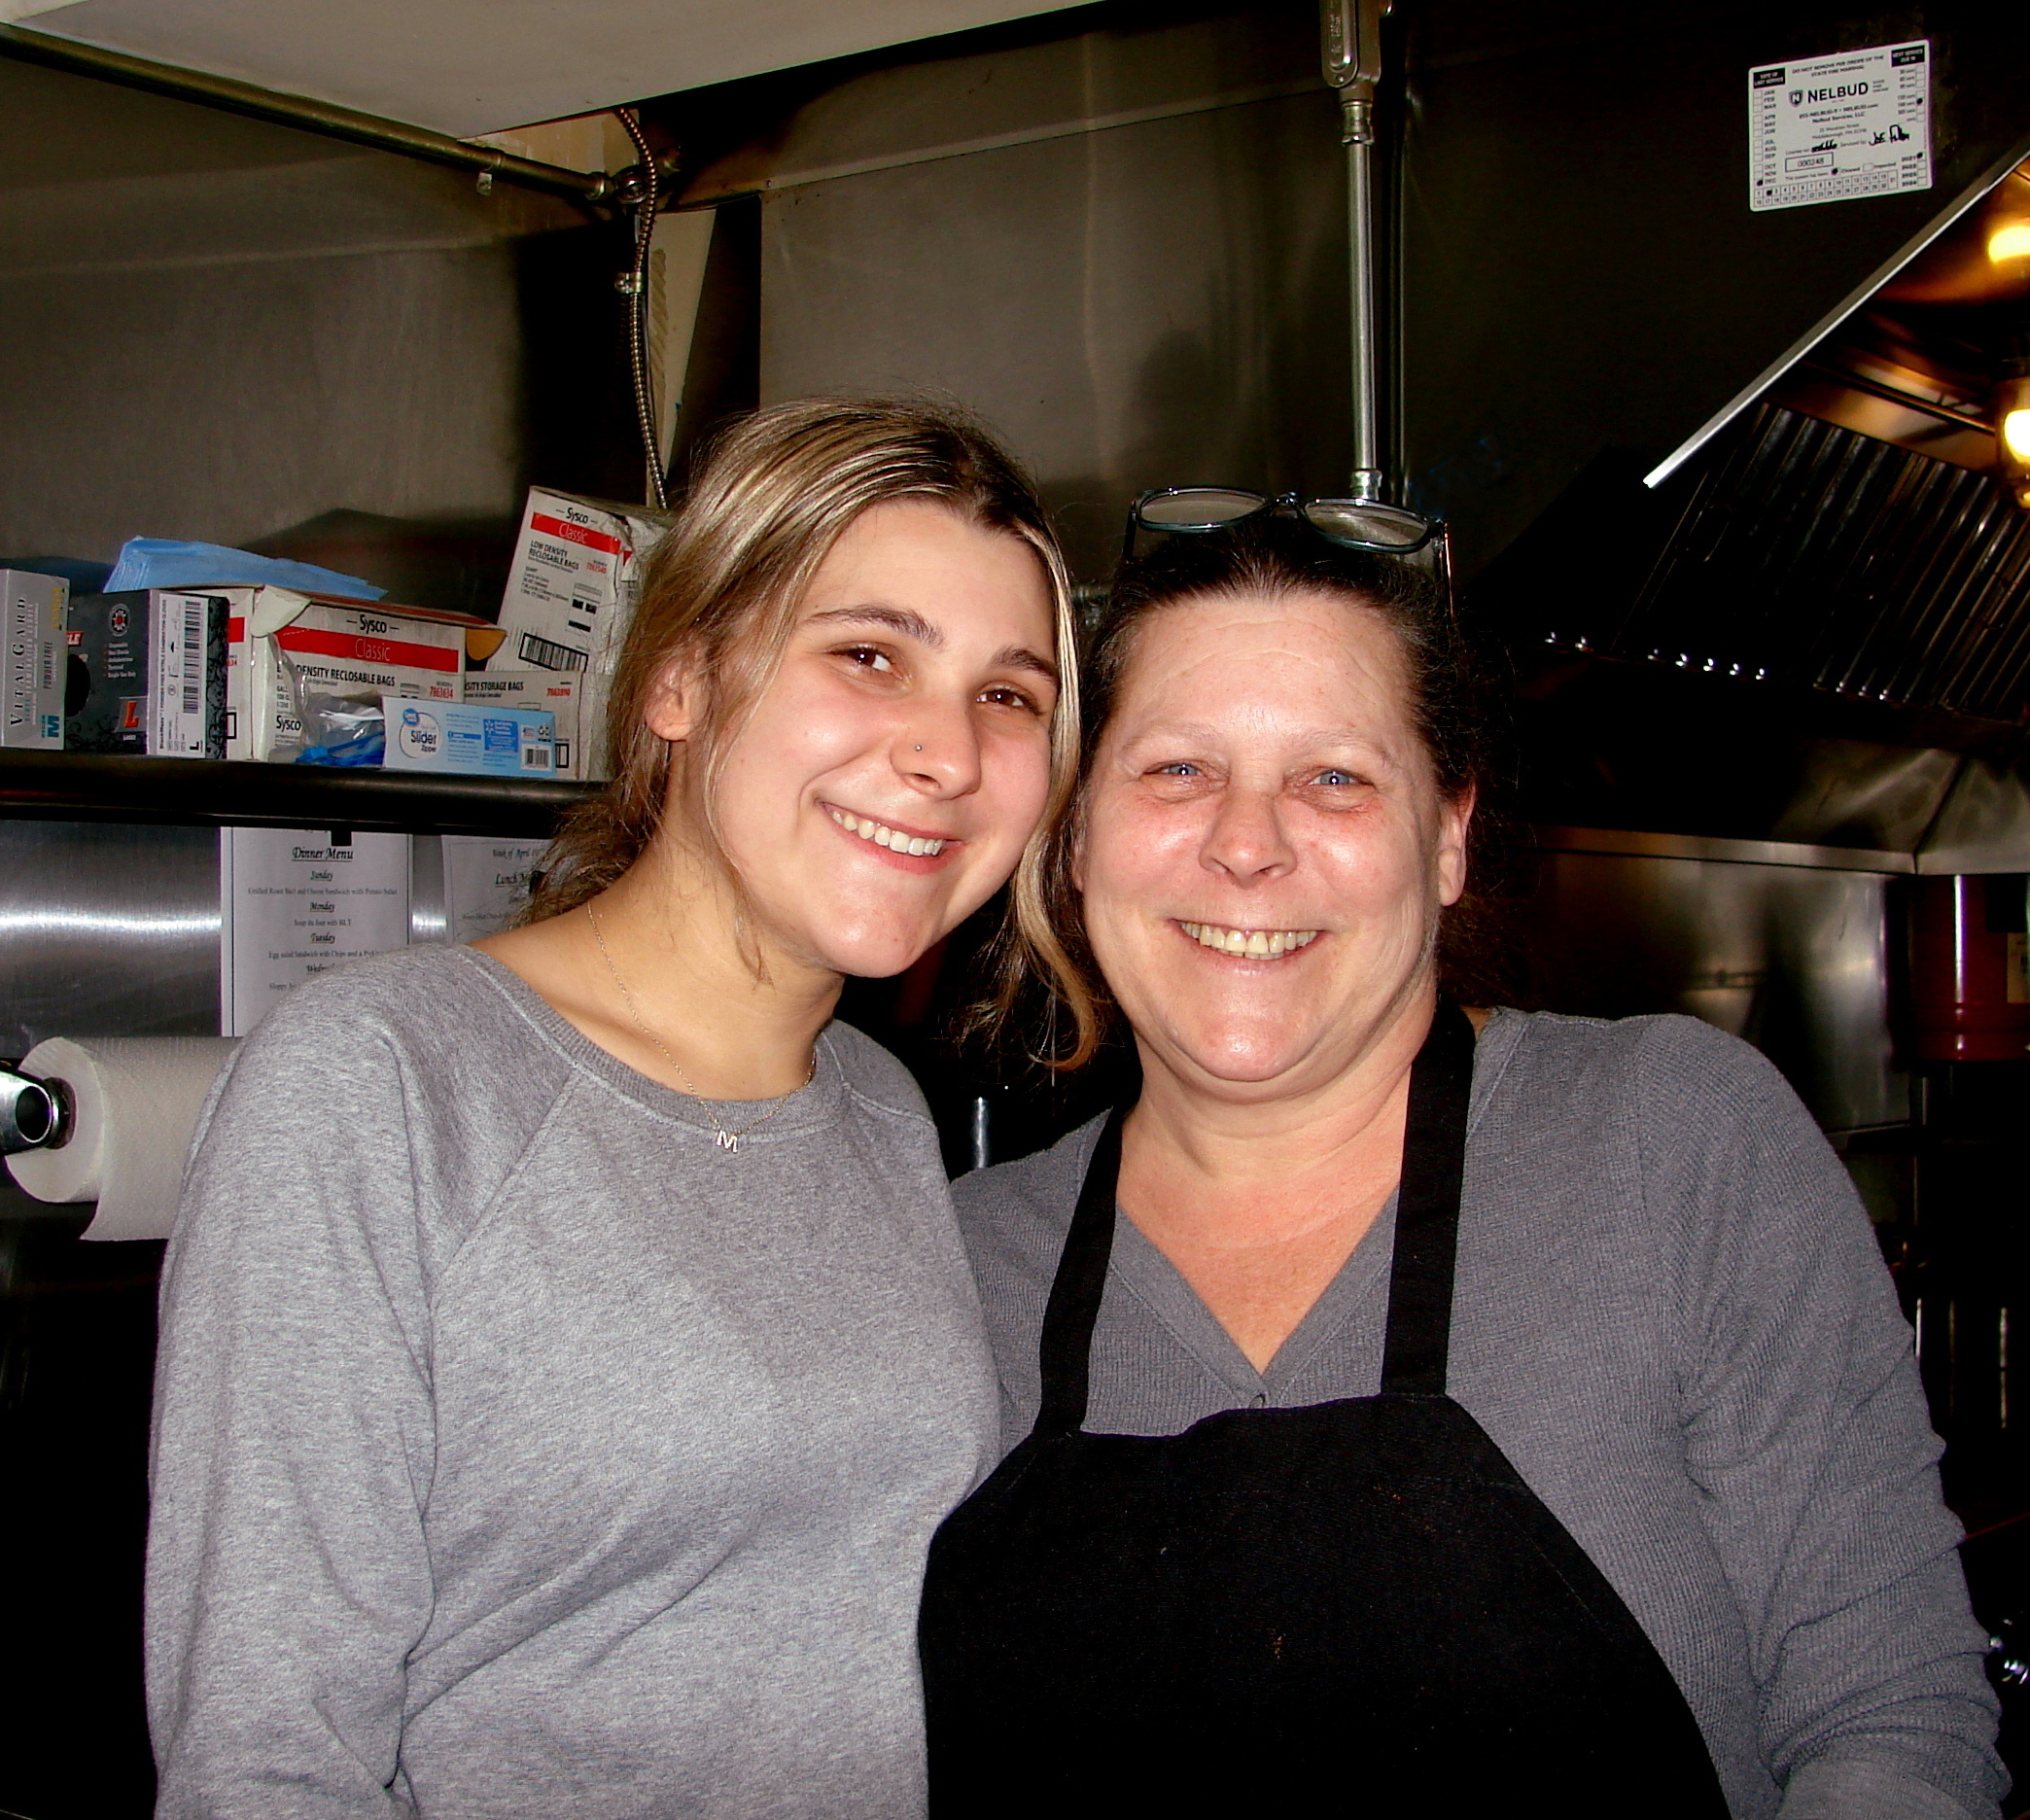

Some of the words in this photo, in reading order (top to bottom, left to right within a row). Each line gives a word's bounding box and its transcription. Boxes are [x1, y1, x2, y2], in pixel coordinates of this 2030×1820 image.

[1808, 82, 1869, 104] NELBUD
[566, 507, 589, 524] Sysco
[558, 523, 589, 545] Classic
[531, 541, 543, 550] LOW
[544, 544, 568, 556] DENSITY
[528, 548, 564, 565] RECLOSABLE
[565, 555, 579, 570] BAGS
[360, 614, 387, 634] Sysco
[44, 641, 52, 658] FREE
[355, 638, 391, 662] Classic
[43, 660, 52, 690] POWDER
[331, 668, 375, 684] RECLOSABLE
[377, 676, 395, 687] BAGS
[481, 682, 507, 691] STORAGE
[508, 682, 524, 691] BAGS
[124, 701, 140, 728] L
[276, 715, 301, 732] Sysco
[189, 741, 199, 750] L
[411, 730, 437, 745] Slider
[292, 846, 323, 859] Dinner
[325, 847, 354, 860] Menu
[311, 870, 333, 881] Sunday
[495, 871, 518, 885] Lunch
[310, 901, 335, 912] Monday
[311, 932, 335, 944] Tuesday
[268, 951, 280, 960] Egg
[716, 1130, 738, 1153] M
